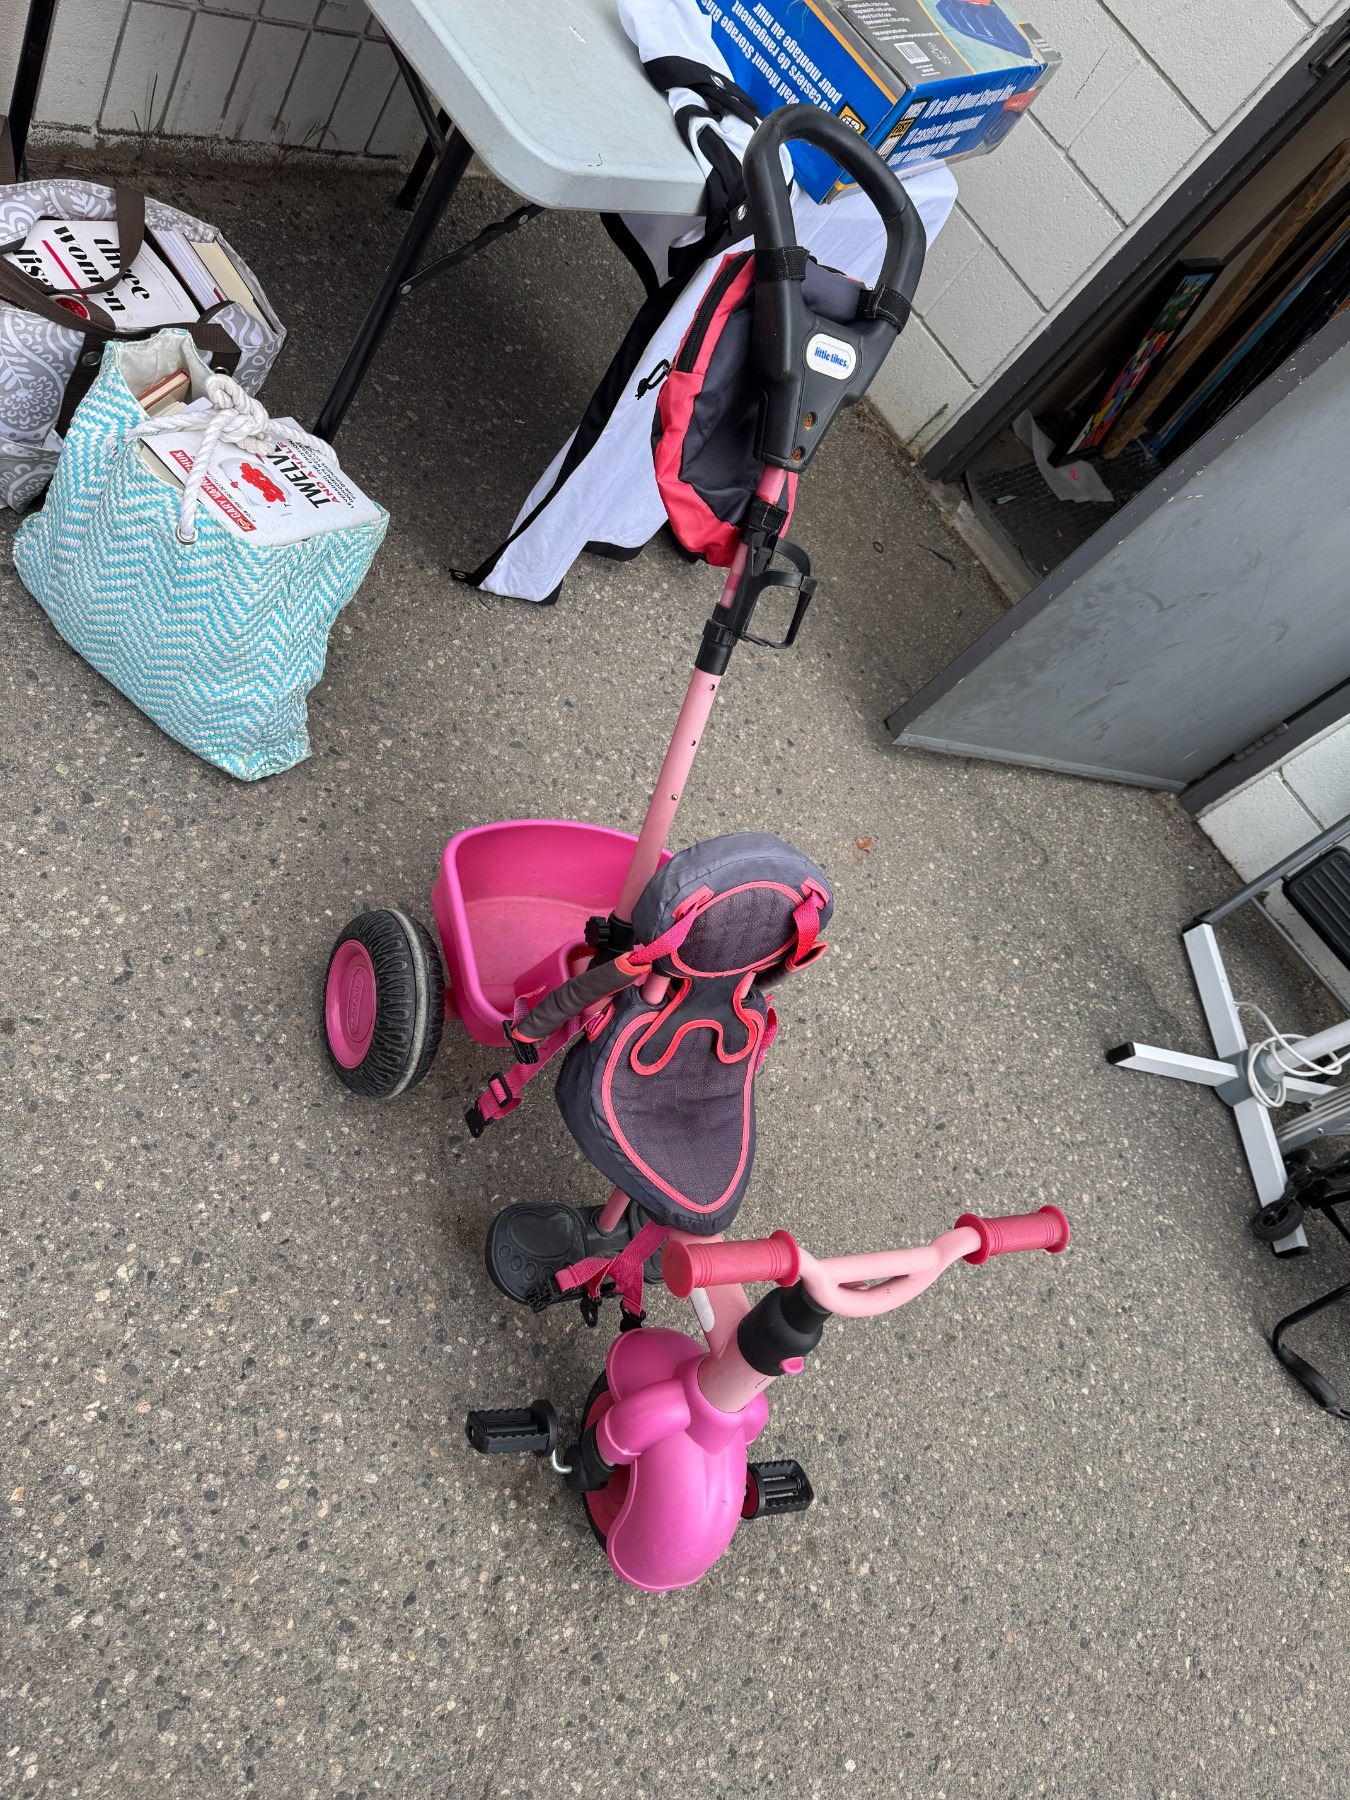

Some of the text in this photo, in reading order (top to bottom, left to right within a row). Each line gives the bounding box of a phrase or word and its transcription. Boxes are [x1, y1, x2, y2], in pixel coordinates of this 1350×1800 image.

[720, 15, 755, 58] Storage
[731, 0, 779, 56] rangement
[750, 52, 782, 88] Mount
[752, 3, 843, 104] pour montage au mur
[777, 52, 791, 70] de
[777, 82, 801, 104] Wall
[788, 65, 822, 104] casiers
[53, 226, 126, 312] womn
[814, 347, 830, 361] little
[266, 444, 331, 509] TWELV
[278, 442, 341, 503] AND A HALF
[219, 500, 240, 519] GARY
